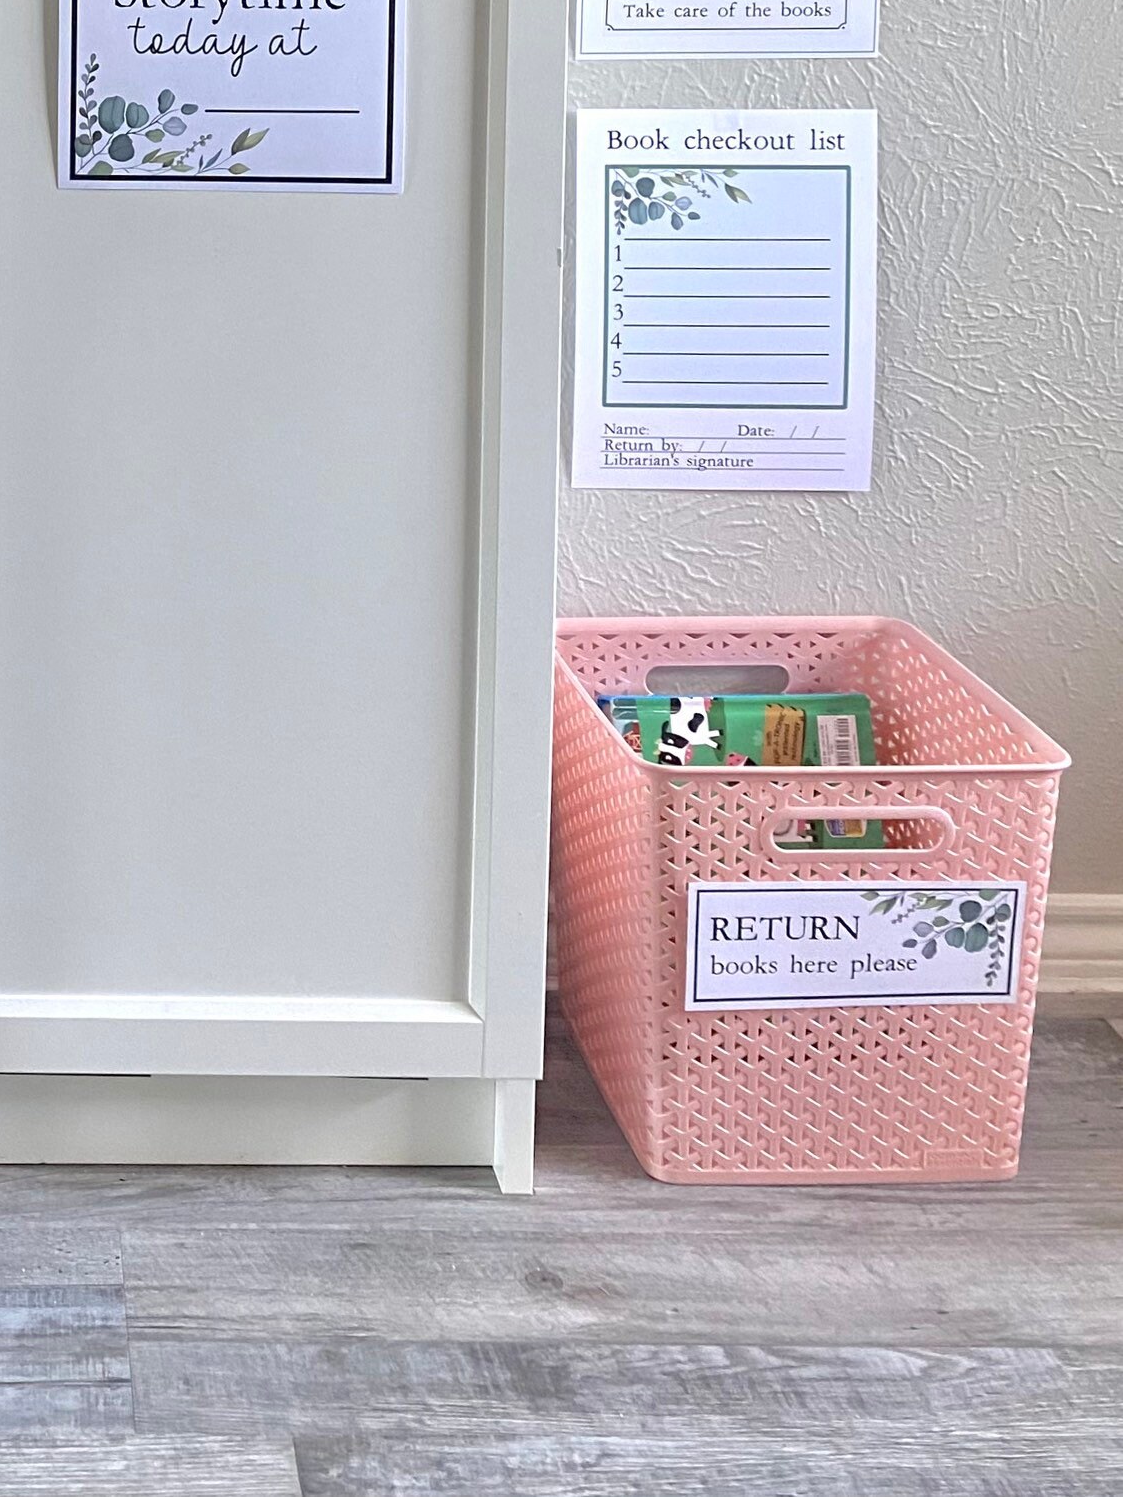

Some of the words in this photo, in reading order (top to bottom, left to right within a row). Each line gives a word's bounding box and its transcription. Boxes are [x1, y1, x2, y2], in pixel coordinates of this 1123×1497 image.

[624, 3, 664, 17] Take
[674, 6, 708, 18] care
[718, 2, 737, 17] of
[746, 3, 771, 17] the
[781, 2, 831, 16] books
[128, 17, 258, 77] today
[269, 19, 317, 55] at
[608, 130, 669, 149] Book
[685, 130, 794, 150] checkout
[811, 130, 844, 150] list
[614, 245, 623, 262] 1
[613, 276, 623, 291] 2
[614, 304, 623, 320] 3
[611, 333, 622, 349] 4
[612, 361, 621, 377] 5
[604, 423, 650, 436] Name:
[738, 425, 774, 436] Date:
[605, 440, 653, 451] Return
[661, 438, 683, 452] by:
[605, 454, 679, 466] Librarian's
[687, 456, 754, 470] signature
[711, 916, 859, 941] RETURN
[711, 955, 777, 975] books
[791, 955, 837, 973] here
[851, 953, 917, 979] please
